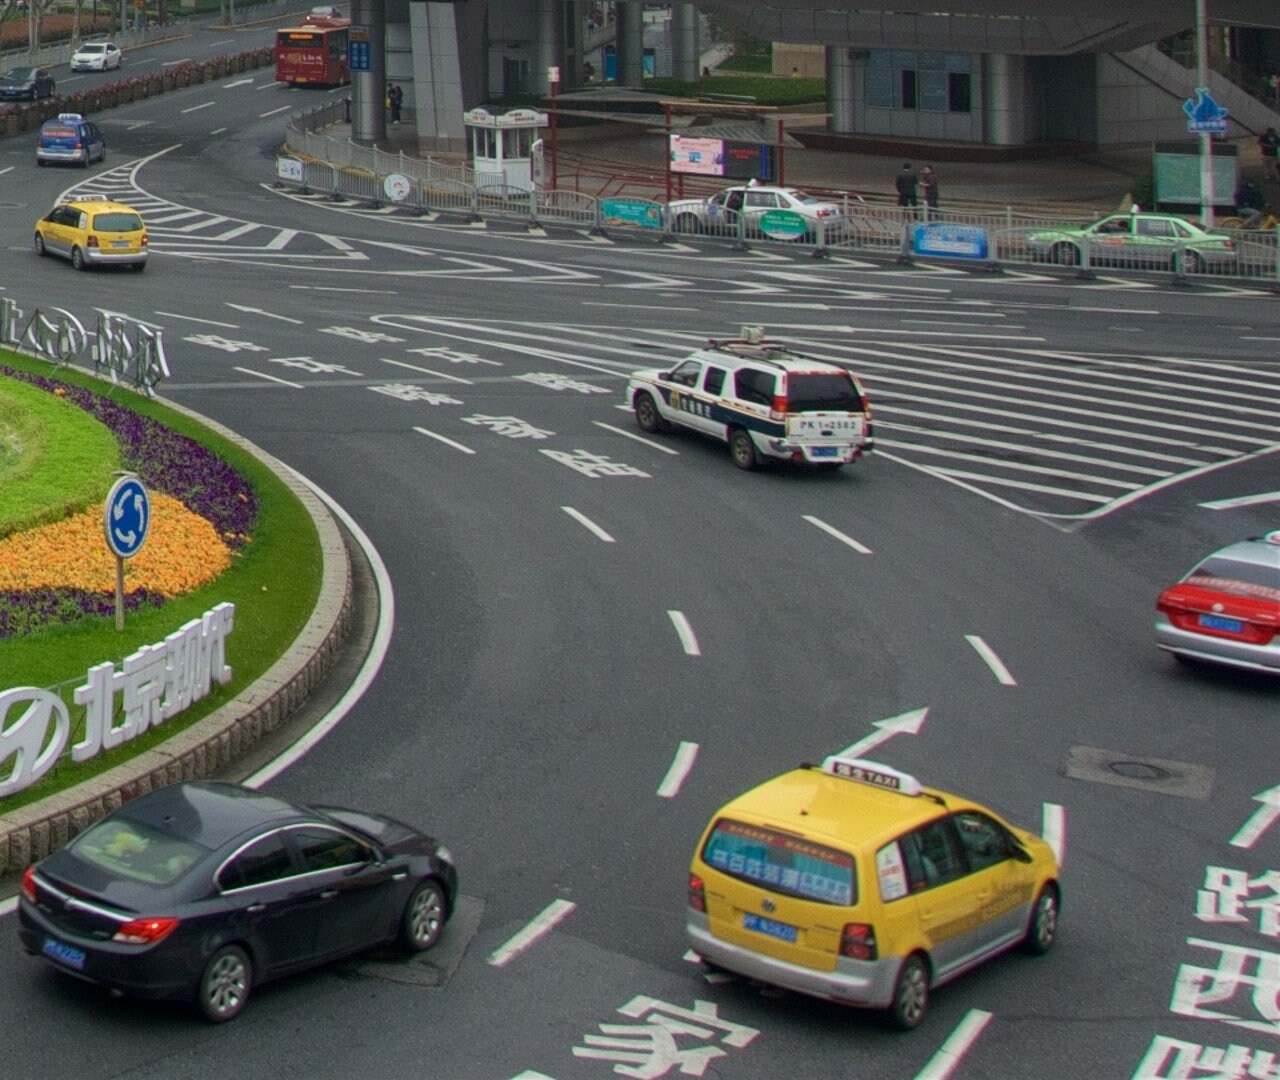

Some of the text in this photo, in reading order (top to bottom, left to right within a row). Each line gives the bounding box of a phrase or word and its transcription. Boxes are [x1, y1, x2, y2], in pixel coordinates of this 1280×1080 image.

[71, 601, 236, 763] 北京现代
[866, 770, 898, 788] TAXI
